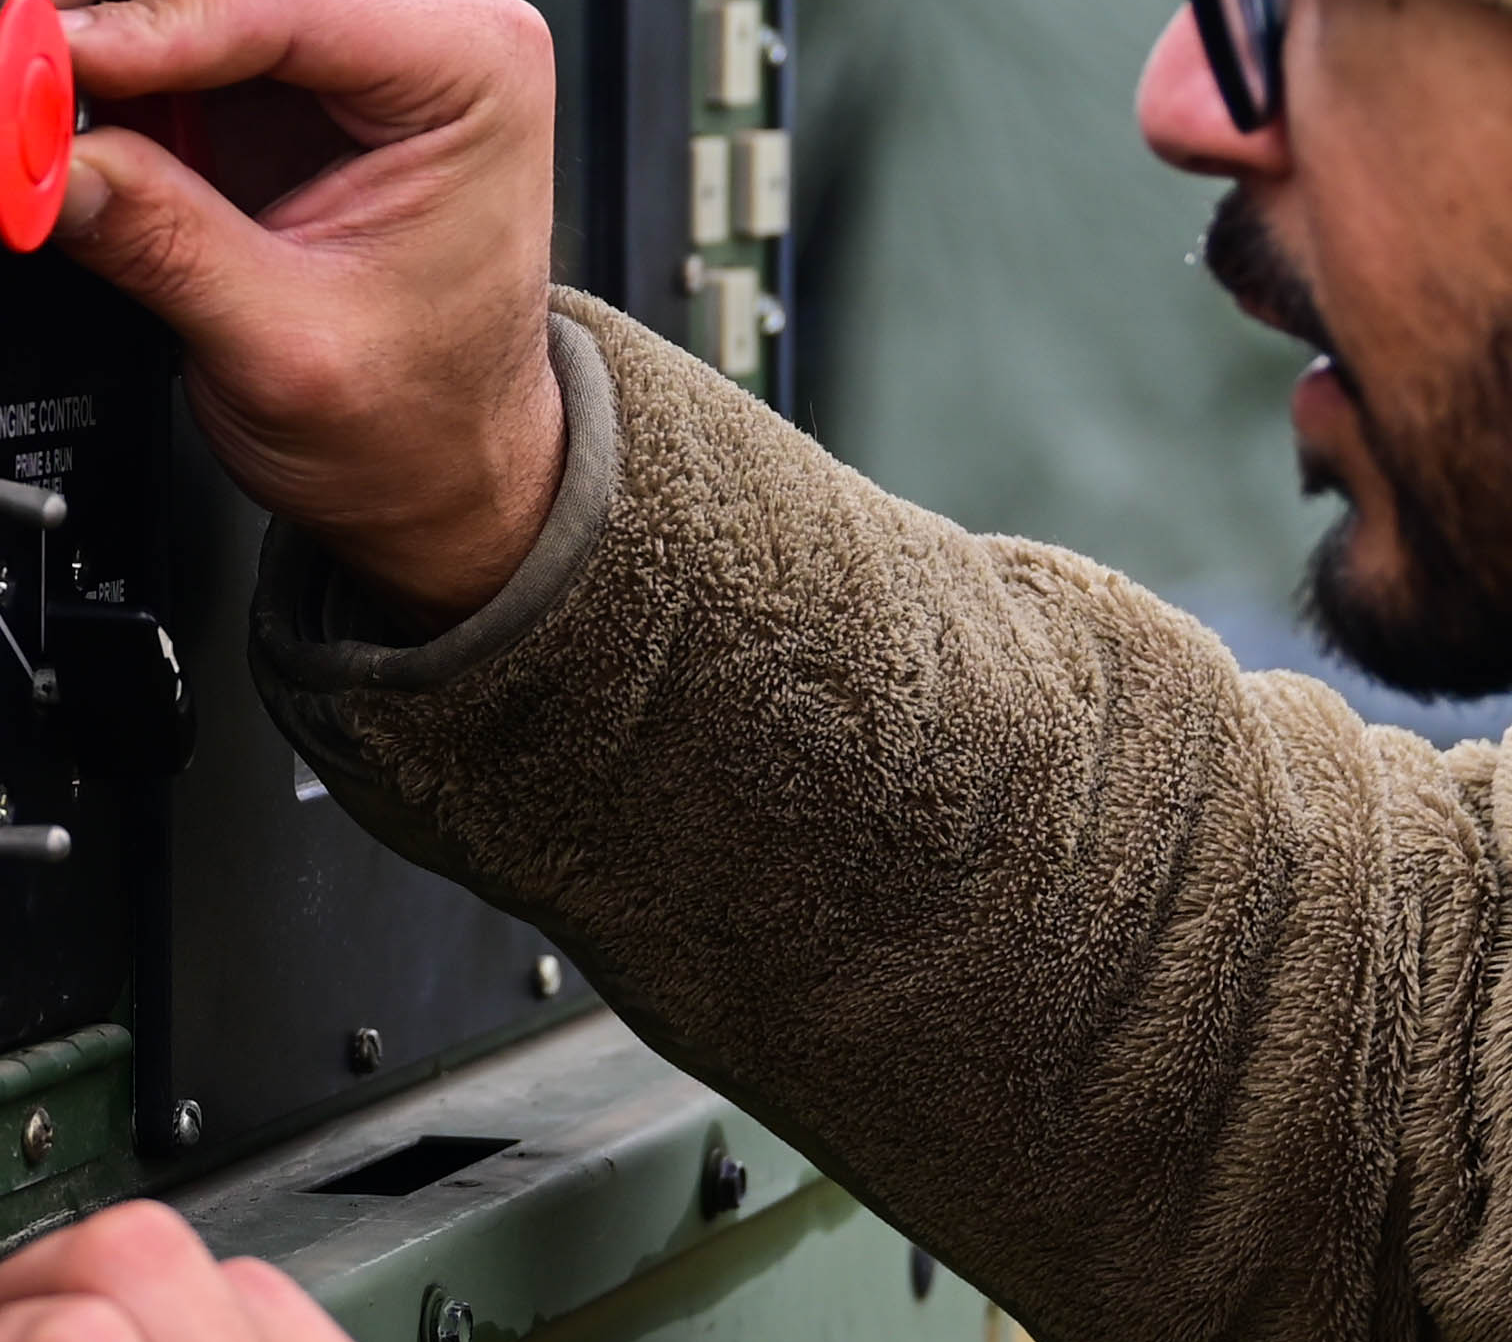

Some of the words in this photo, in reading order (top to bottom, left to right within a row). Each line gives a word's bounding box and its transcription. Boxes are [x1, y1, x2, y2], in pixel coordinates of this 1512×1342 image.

[38, 395, 96, 434] CONTROL
[15, 450, 44, 480] PRIME
[44, 449, 52, 474] &
[53, 445, 73, 474] RUN
[98, 579, 125, 603] PRIME
